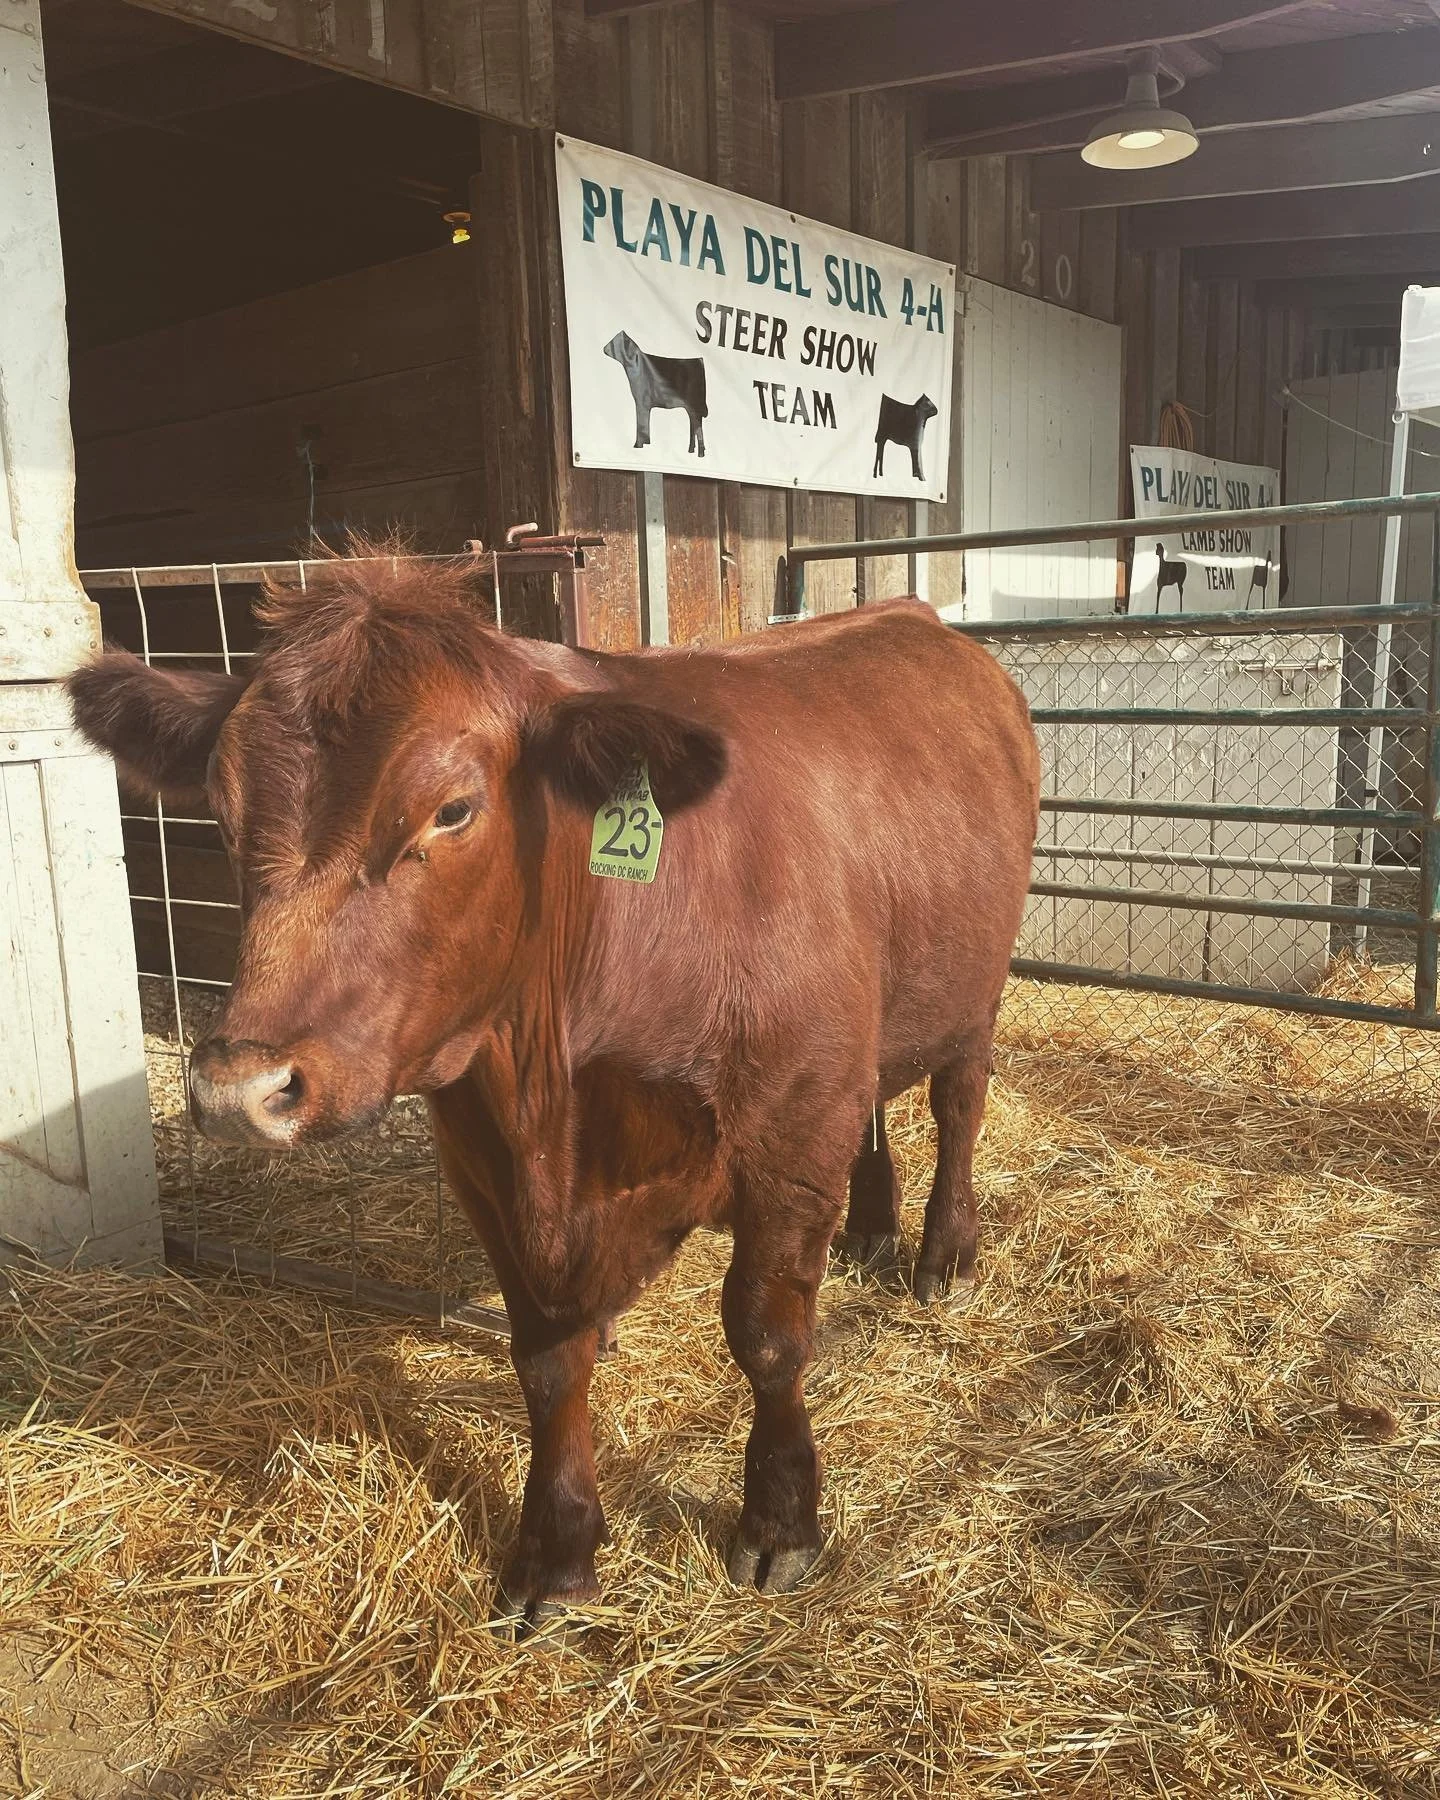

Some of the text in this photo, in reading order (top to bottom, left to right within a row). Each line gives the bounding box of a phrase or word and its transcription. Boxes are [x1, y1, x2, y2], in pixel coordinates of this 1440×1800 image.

[580, 177, 945, 334] PLAYA DEL SUR 4-H
[1020, 240, 1072, 298] 20
[695, 301, 878, 377] STEER SHOW
[753, 380, 837, 430] TEAM
[1193, 475, 1222, 510] DEL
[1225, 480, 1250, 510] SUR
[1181, 528, 1252, 553] LAMB SHOW
[1205, 566, 1235, 590] TEAM
[590, 862, 649, 880] ROCKING DC RANCH
